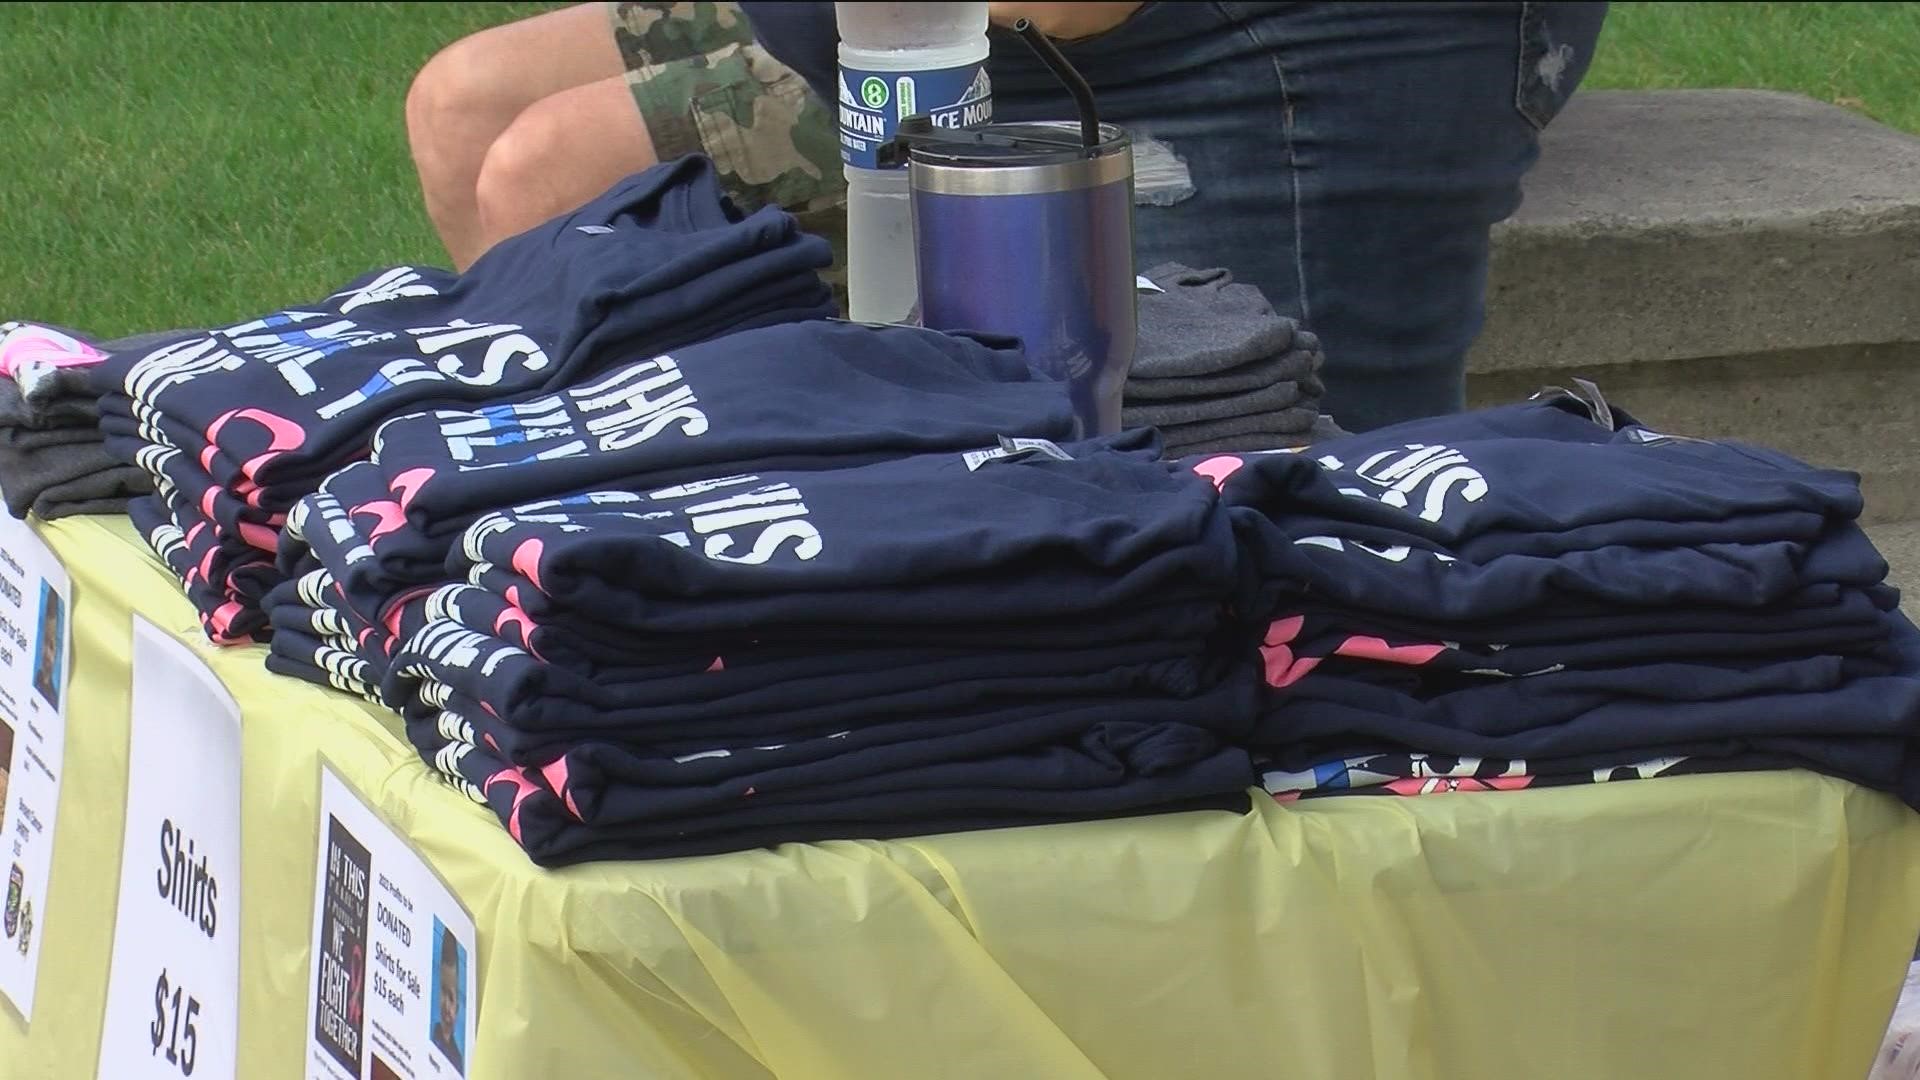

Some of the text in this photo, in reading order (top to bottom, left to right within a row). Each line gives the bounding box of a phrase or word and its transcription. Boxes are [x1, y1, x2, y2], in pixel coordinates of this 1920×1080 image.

[930, 110, 960, 129] ICE
[568, 354, 709, 452] THIS
[156, 818, 217, 938] Shirts
[330, 841, 365, 901] IN THIS
[331, 917, 345, 962] WE
[377, 901, 411, 948] DONATED
[320, 952, 350, 1020] FIGHT
[374, 970, 404, 1016] $15 each
[375, 941, 420, 1000] Shirts for Sale
[151, 967, 200, 1077] $15
[320, 999, 358, 1061] TOGETHER
